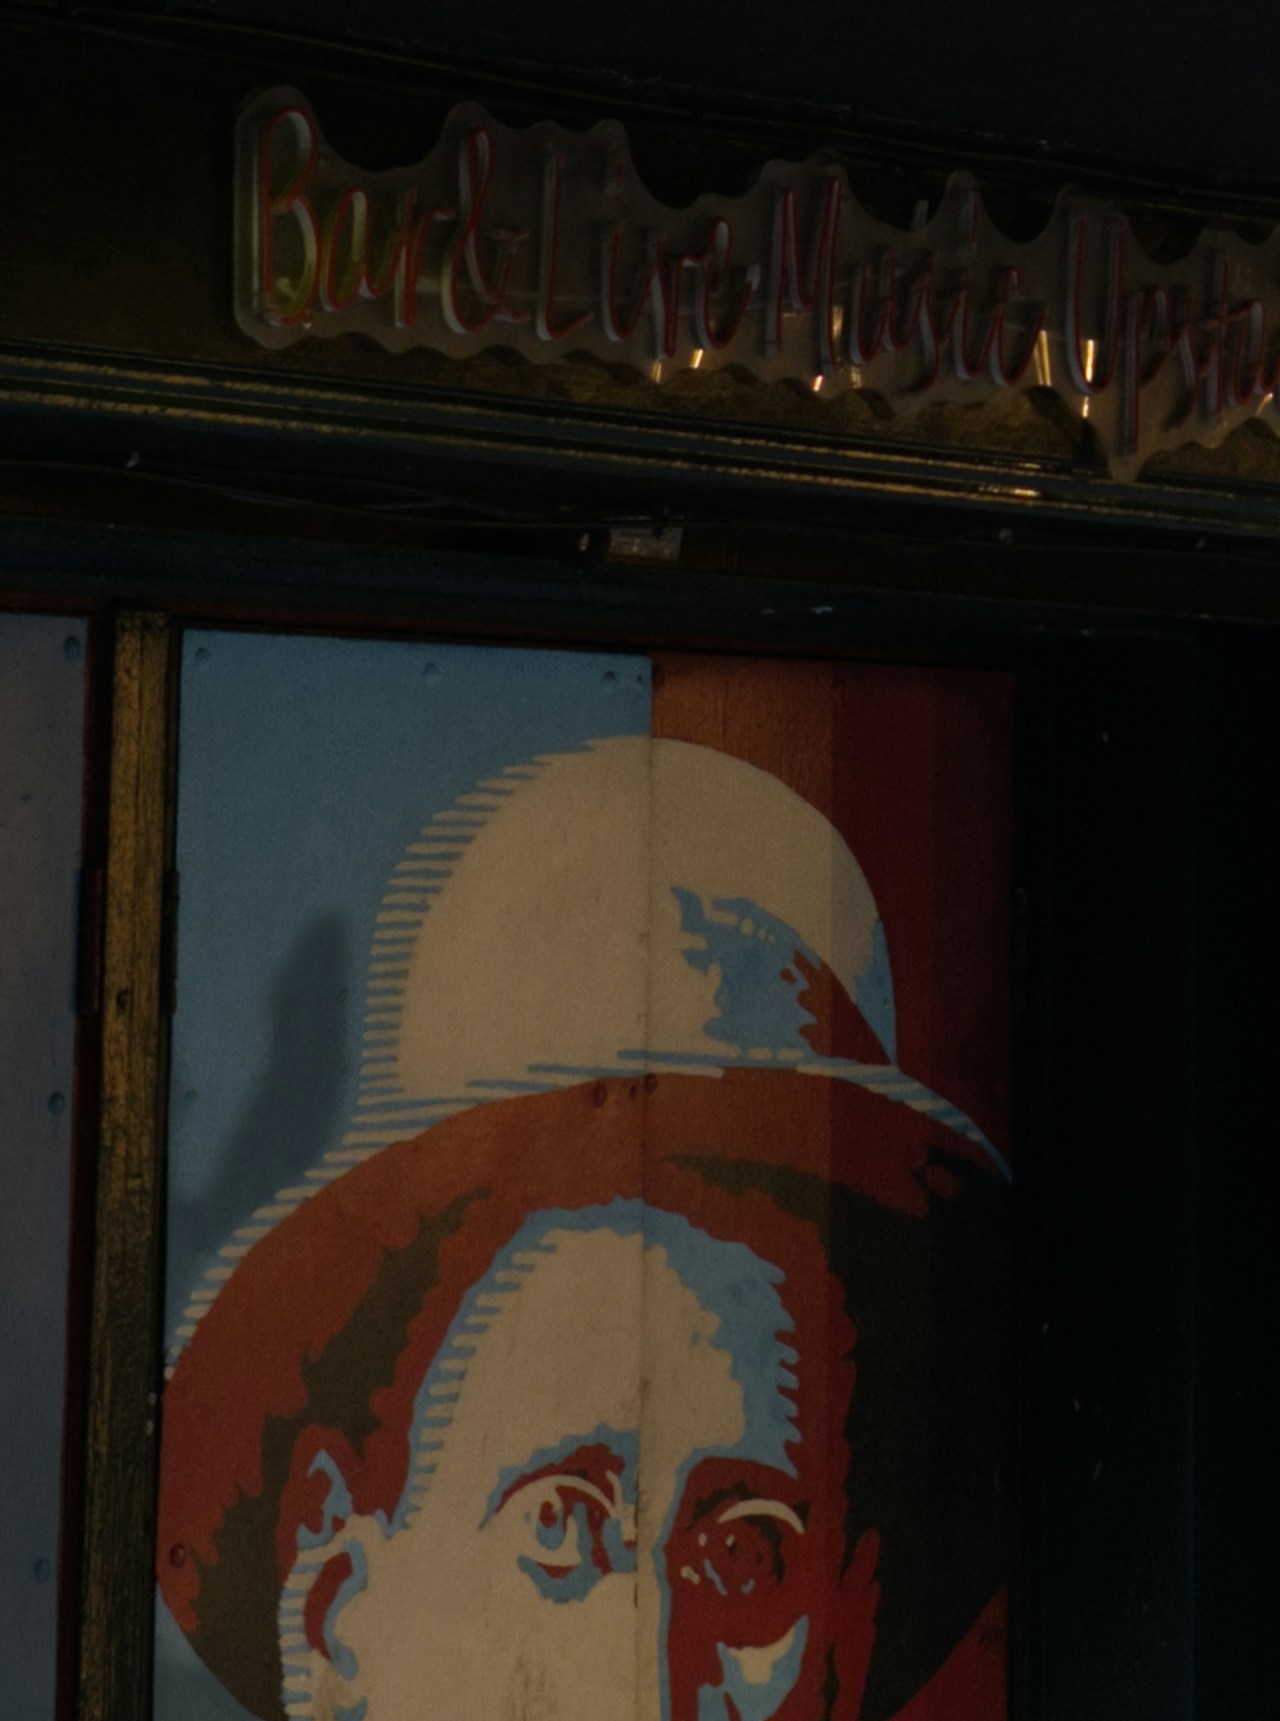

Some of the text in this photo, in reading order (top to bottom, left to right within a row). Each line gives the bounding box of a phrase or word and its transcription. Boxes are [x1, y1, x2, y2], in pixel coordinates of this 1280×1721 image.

[254, 105, 456, 329] Bar
[535, 141, 762, 359] Live
[764, 175, 1048, 394] Music
